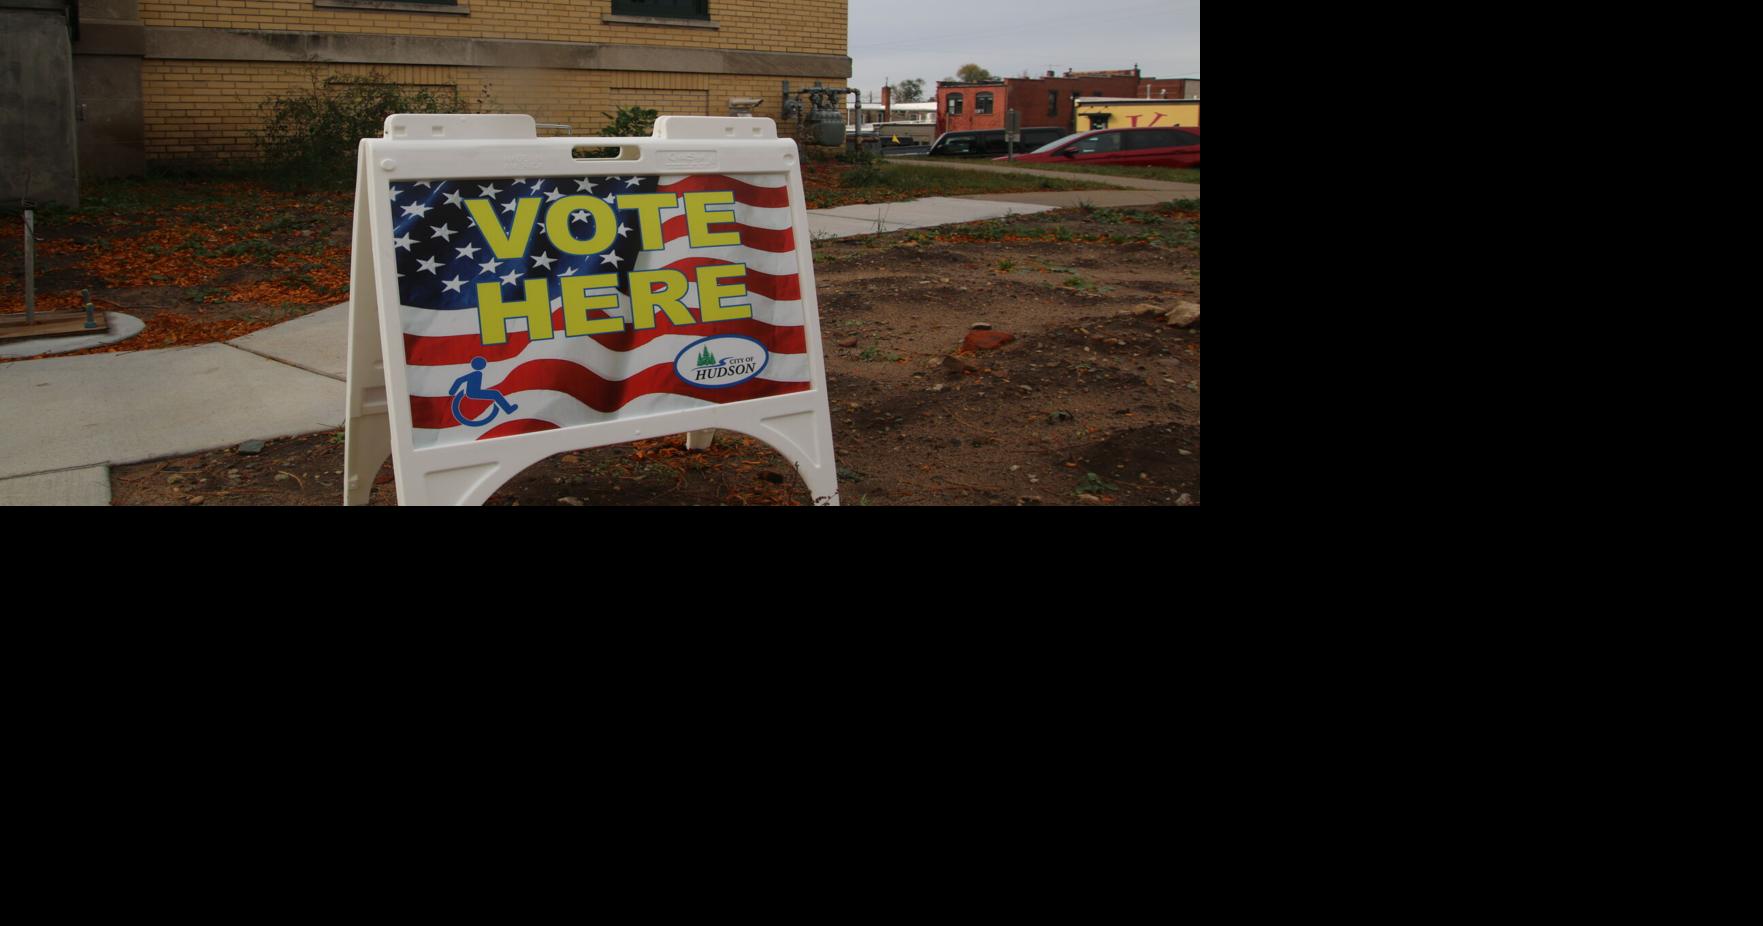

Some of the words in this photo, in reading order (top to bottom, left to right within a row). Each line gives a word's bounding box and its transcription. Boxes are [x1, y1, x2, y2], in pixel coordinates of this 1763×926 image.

[463, 190, 742, 260] VOTE
[475, 263, 753, 346] HERE
[695, 362, 757, 381] HUDSON
[729, 357, 744, 365] CITY
